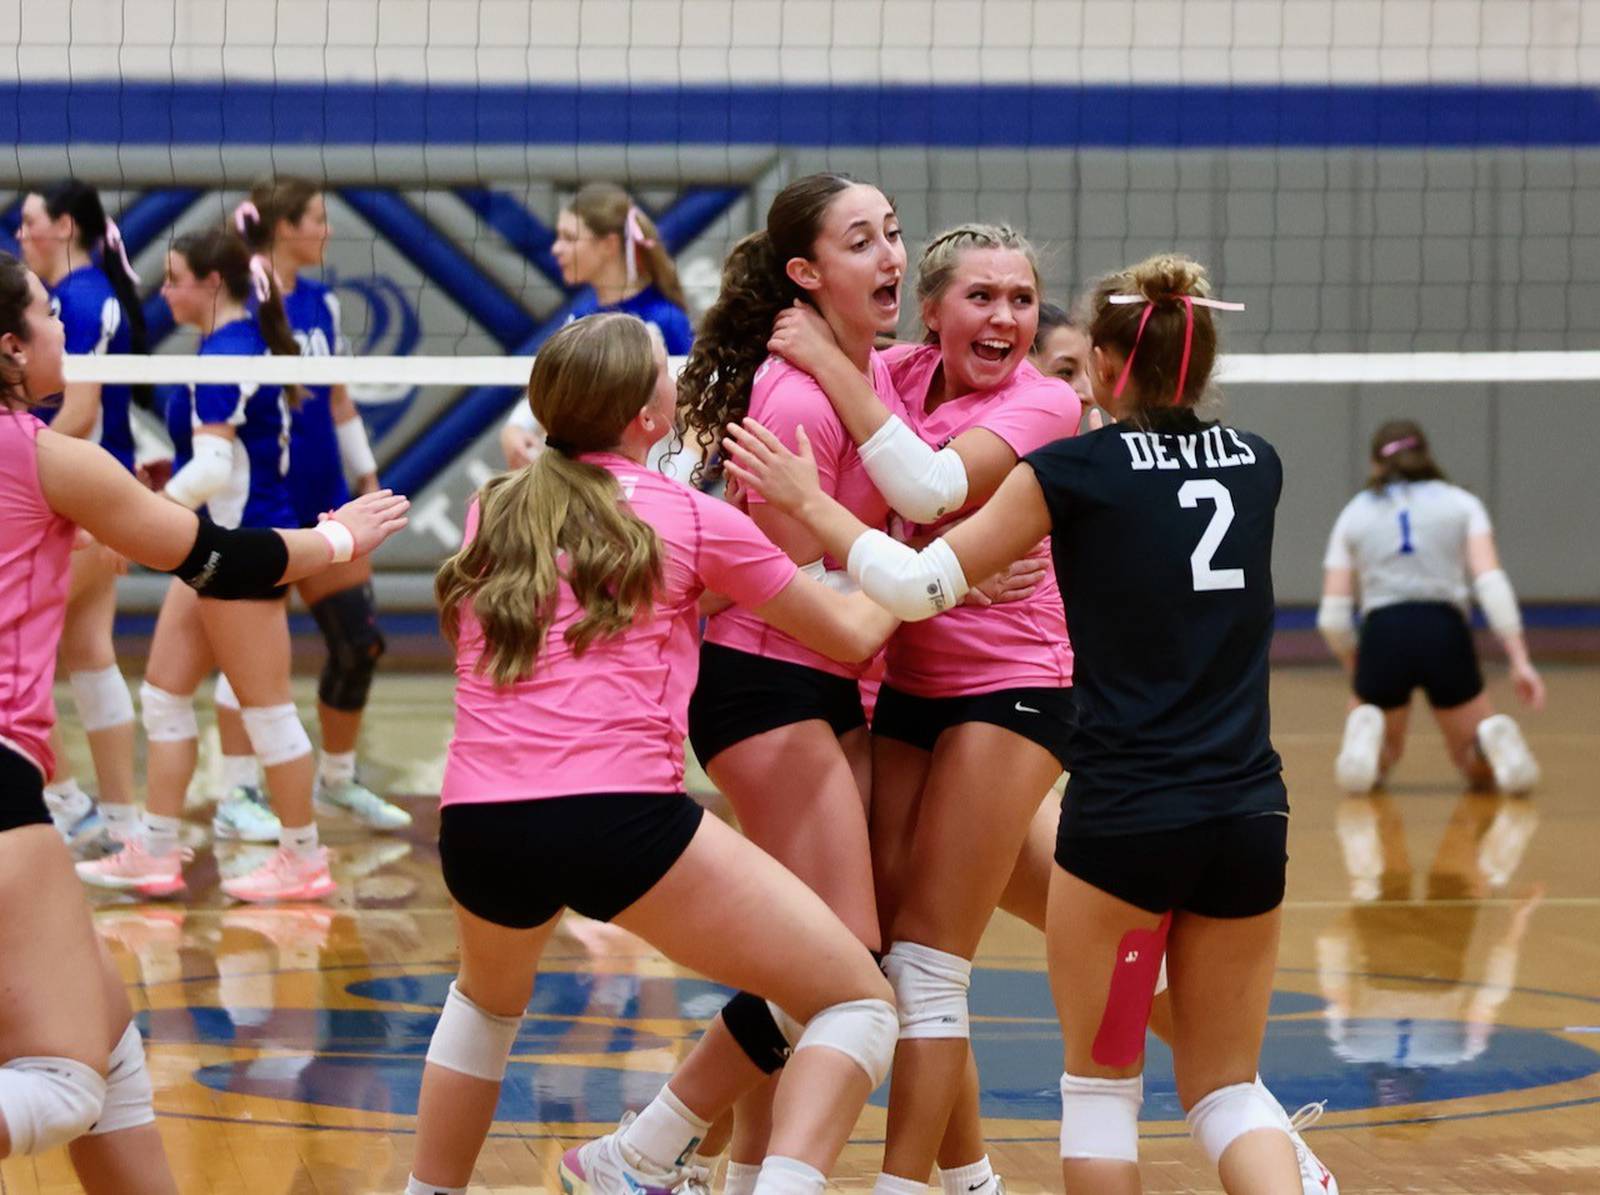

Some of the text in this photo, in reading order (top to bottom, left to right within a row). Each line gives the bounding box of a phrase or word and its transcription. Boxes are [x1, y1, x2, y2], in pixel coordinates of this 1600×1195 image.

[1120, 425, 1256, 470] DEVILS
[1177, 479, 1245, 591] 2
[1398, 510, 1415, 555] 1
